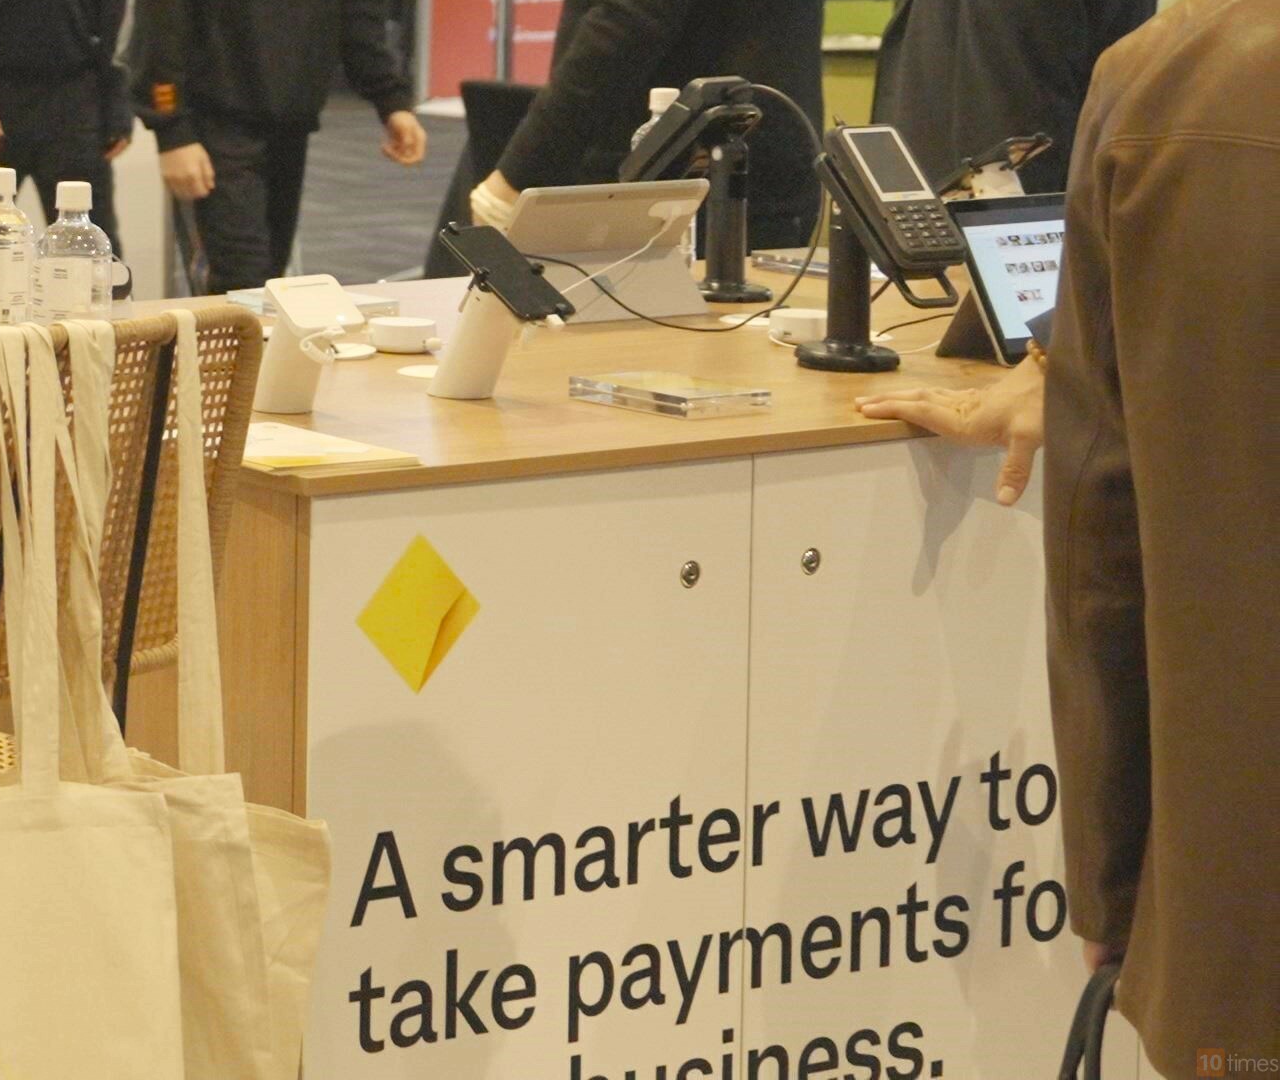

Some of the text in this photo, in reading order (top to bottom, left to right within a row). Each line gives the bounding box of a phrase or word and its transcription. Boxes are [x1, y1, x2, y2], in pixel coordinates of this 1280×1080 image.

[350, 751, 1058, 928] A smarter way to
[349, 949, 537, 1054] take
[567, 883, 971, 1043] payments
[569, 1021, 944, 1080] iness.
